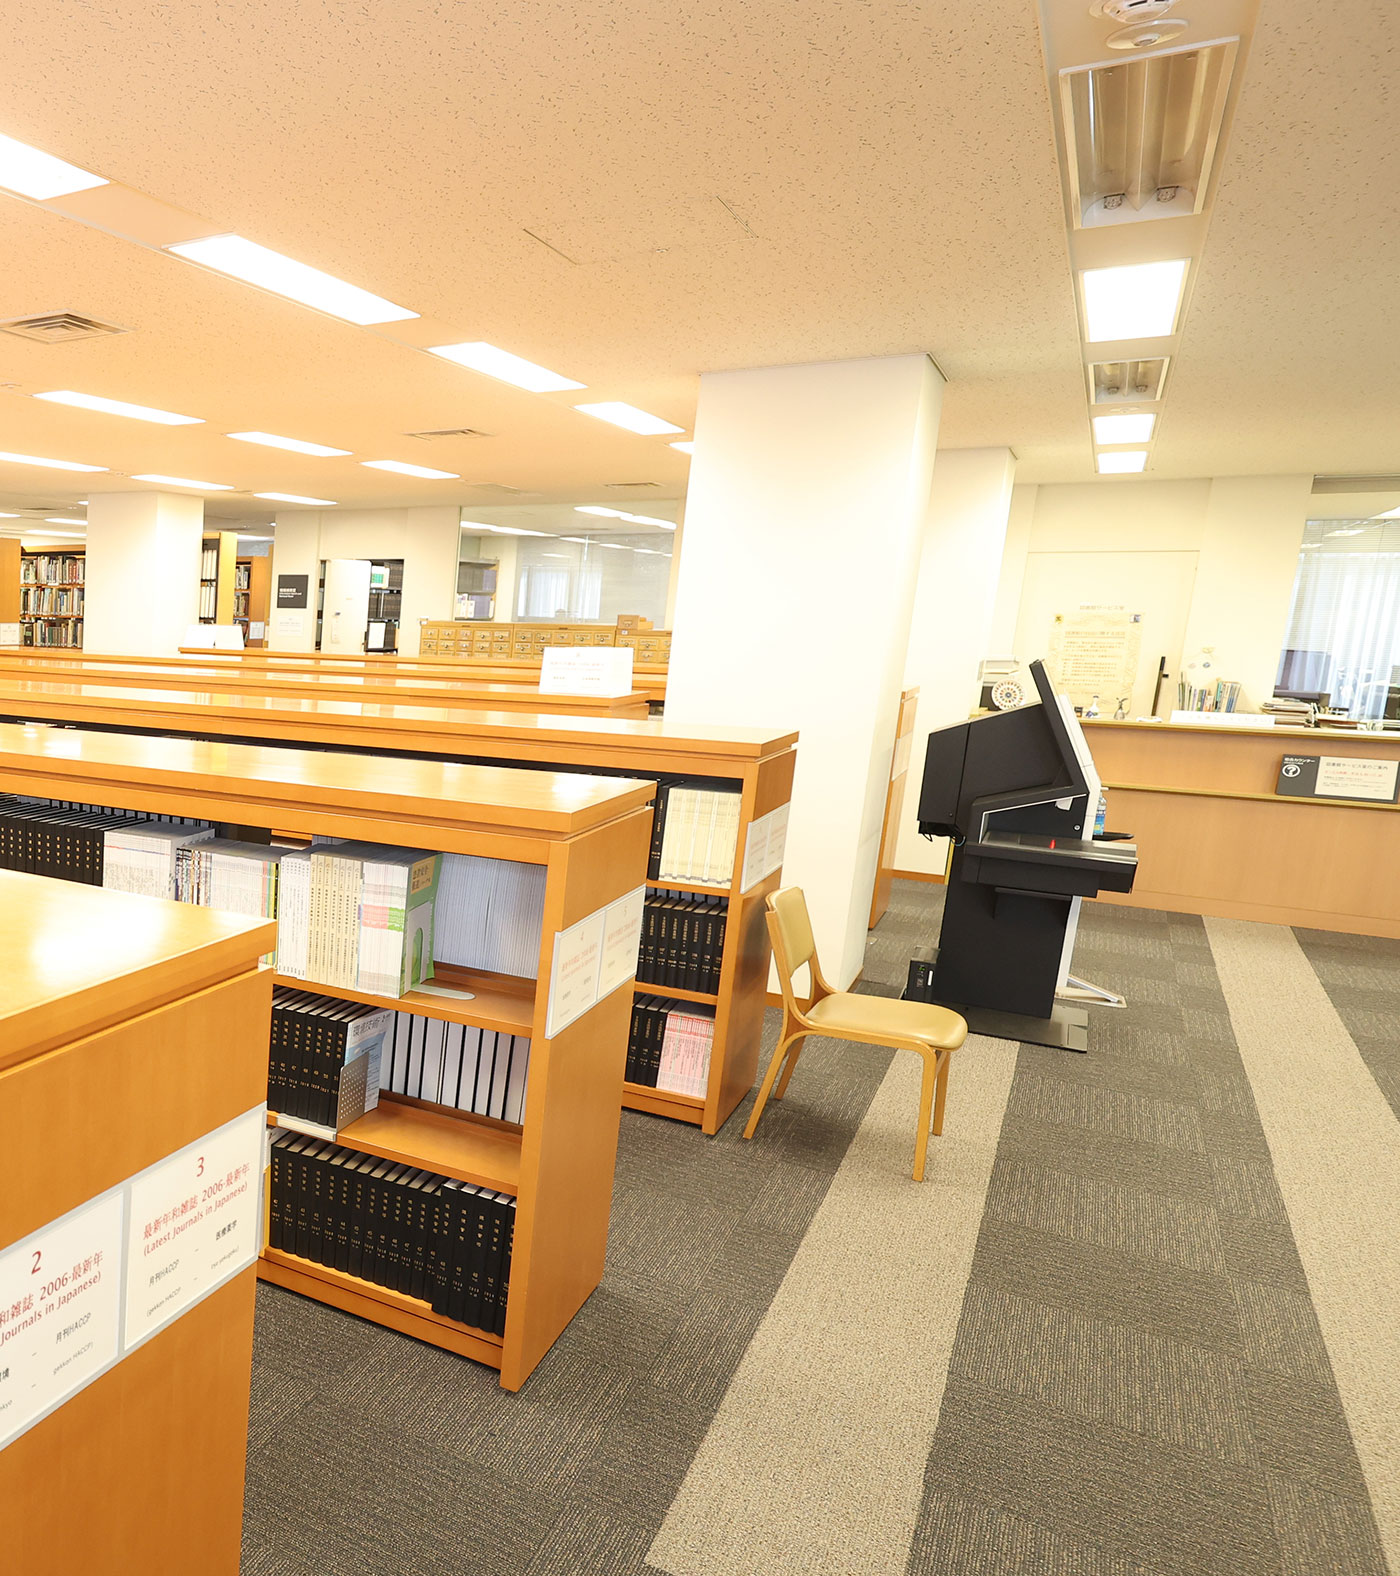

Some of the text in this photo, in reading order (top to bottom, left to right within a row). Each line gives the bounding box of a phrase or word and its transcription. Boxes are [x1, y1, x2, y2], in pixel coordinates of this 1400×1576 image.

[196, 1156, 205, 1178] 3
[143, 1194, 199, 1241] 最新年和雑誌
[143, 1181, 248, 1257] (Latest Journals in Japanese)
[31, 1250, 42, 1275] 2
[0, 1310, 42, 1347] Journals
[45, 1301, 55, 1316] in
[56, 1270, 102, 1311] Japanese)
[55, 1312, 92, 1344] 月刊HACCP
